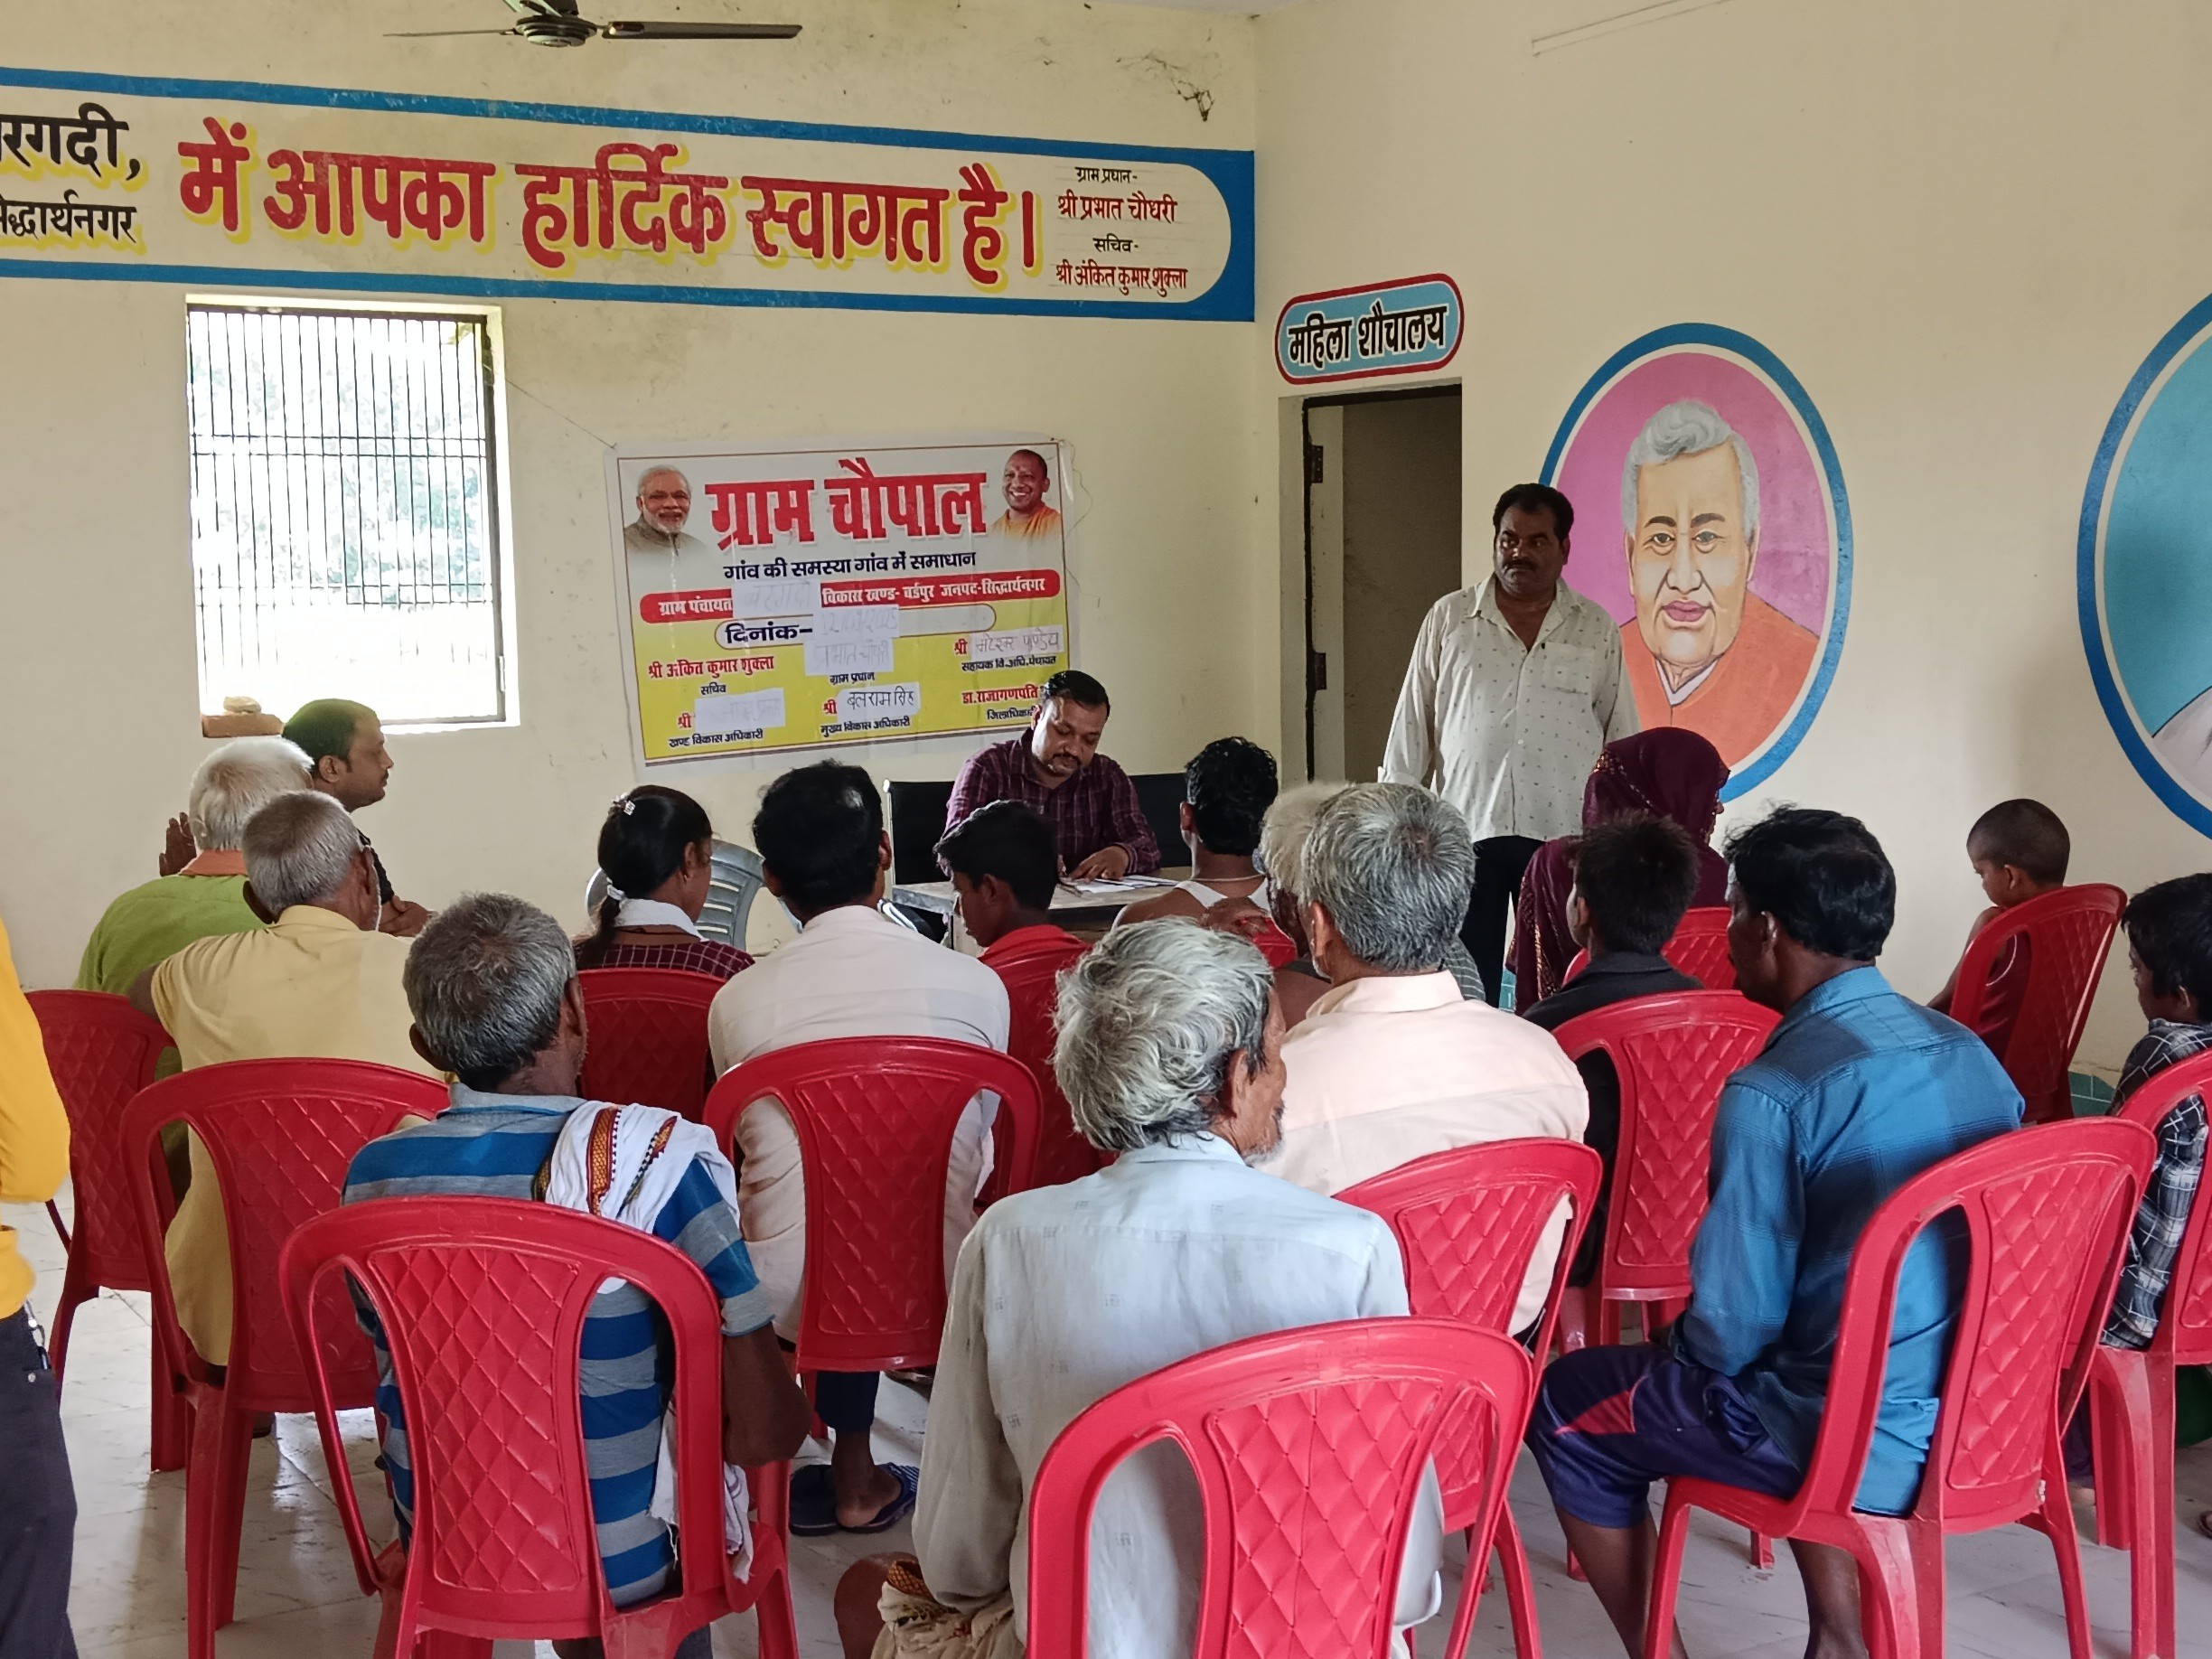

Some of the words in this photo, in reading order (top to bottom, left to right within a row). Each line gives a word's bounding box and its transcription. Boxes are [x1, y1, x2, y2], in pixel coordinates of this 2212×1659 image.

[0, 102, 141, 181] रगदी,
[1074, 166, 1100, 183] ग्राम
[178, 117, 249, 231] में
[264, 148, 496, 243] आपका
[515, 143, 728, 268] हार्दिक
[741, 174, 949, 264] स्वागत
[0, 189, 137, 243] द्धार्थनगर
[1057, 189, 1078, 218] श्री
[1080, 196, 1124, 220] प्रभात
[1127, 190, 1177, 224] चौधरी
[1055, 258, 1073, 285] श्री
[1073, 258, 1117, 287] अंकित
[1118, 266, 1152, 295] कुमार
[1152, 267, 1188, 297] शुक्ला
[1287, 313, 1353, 369] महिला
[1356, 299, 1448, 359] शौचालय
[705, 479, 815, 552] ग्राम
[823, 456, 988, 540] चौपाल
[723, 558, 760, 580] गांव
[763, 557, 787, 578] की
[791, 558, 851, 576] समस्या
[854, 551, 888, 572] गांव
[891, 550, 907, 570] में
[910, 551, 977, 570] समाधान
[658, 599, 687, 616] ग्राम
[688, 595, 734, 614] पंचायत
[821, 587, 863, 605] विकास
[954, 638, 968, 654] श्री
[648, 661, 663, 679] श्री
[707, 659, 738, 679] कुमार
[740, 656, 774, 676] शुक्ला
[700, 681, 726, 695] सचिव
[830, 673, 848, 685] ग्राम
[823, 698, 837, 714] श्री
[678, 712, 692, 728] श्री
[844, 720, 871, 732] विकास
[873, 715, 911, 729] अधिकारी
[692, 733, 723, 745] विकास
[725, 728, 764, 742] अधिकारी
